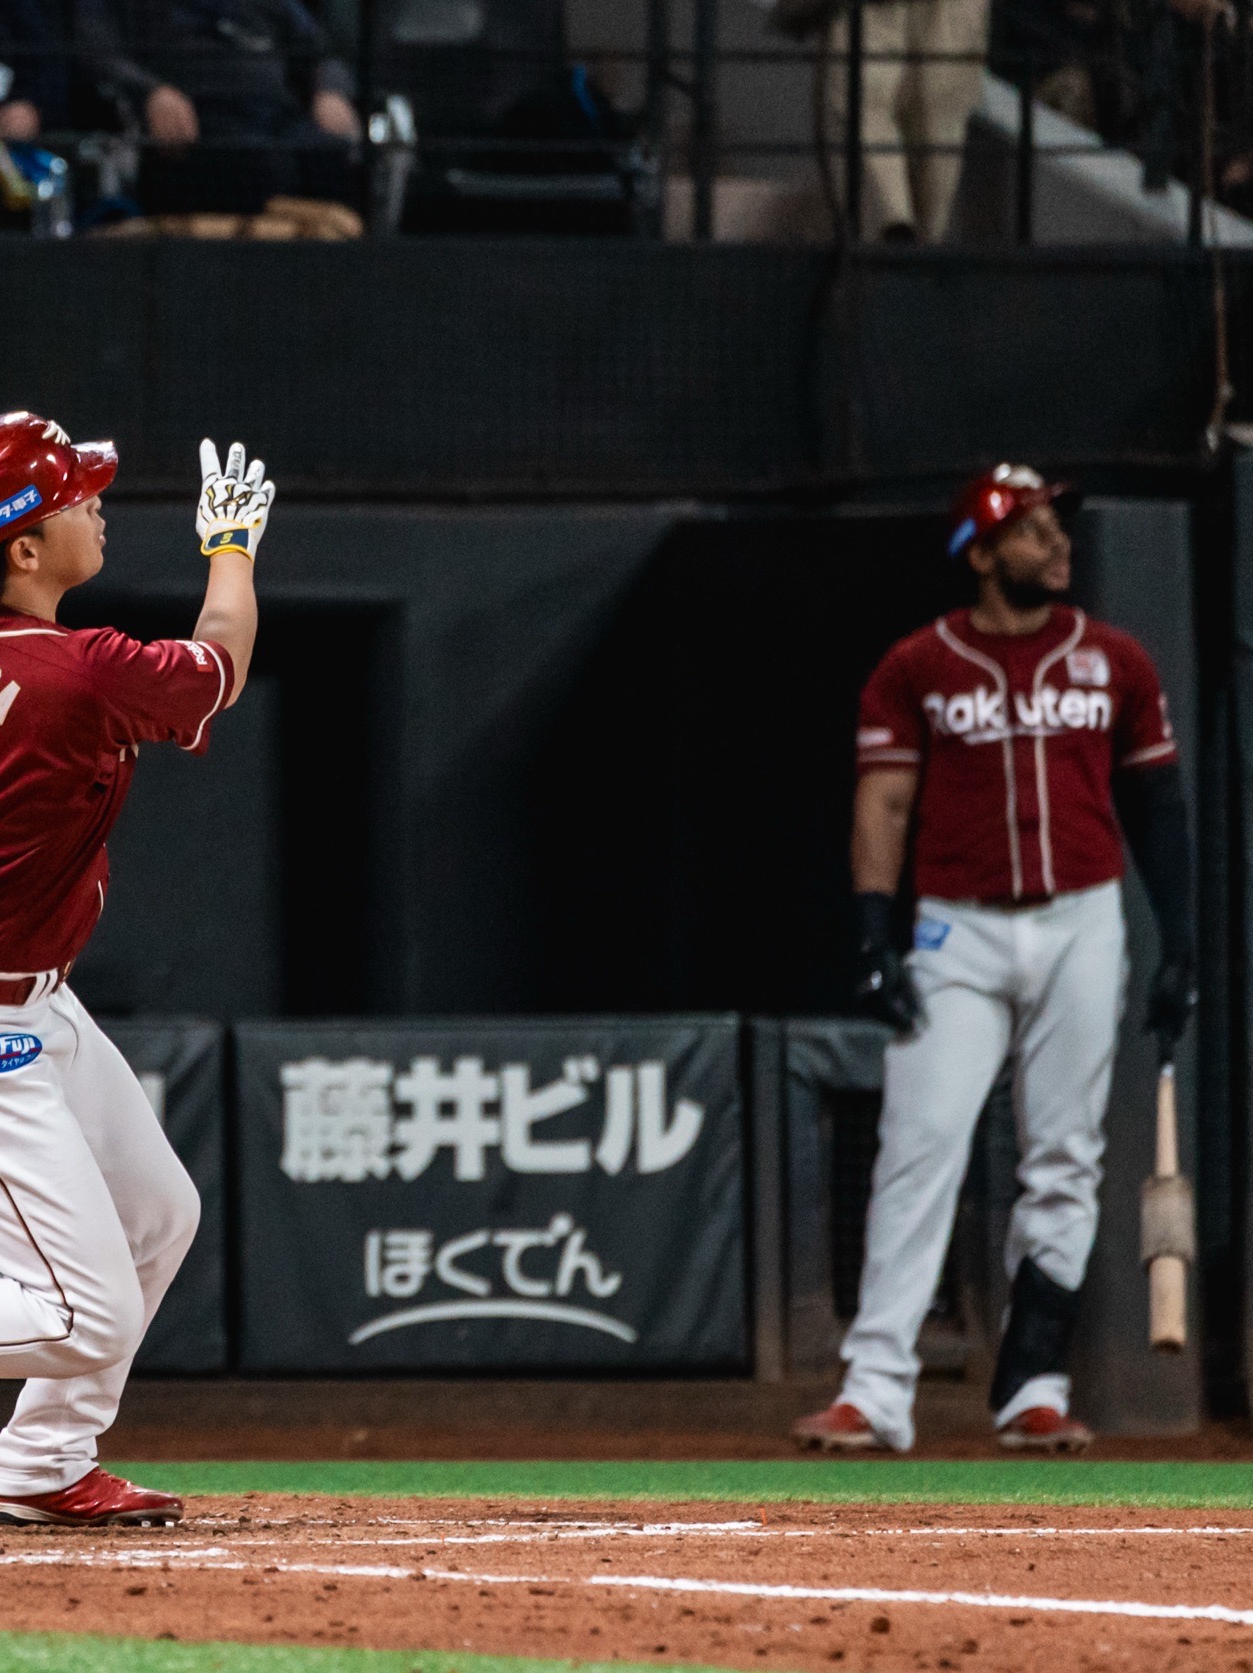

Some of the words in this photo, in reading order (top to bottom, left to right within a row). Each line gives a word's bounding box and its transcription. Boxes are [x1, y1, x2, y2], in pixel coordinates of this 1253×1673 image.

[279, 1055, 705, 1183] 藤井ビル
[364, 1213, 624, 1299] ほくでん
